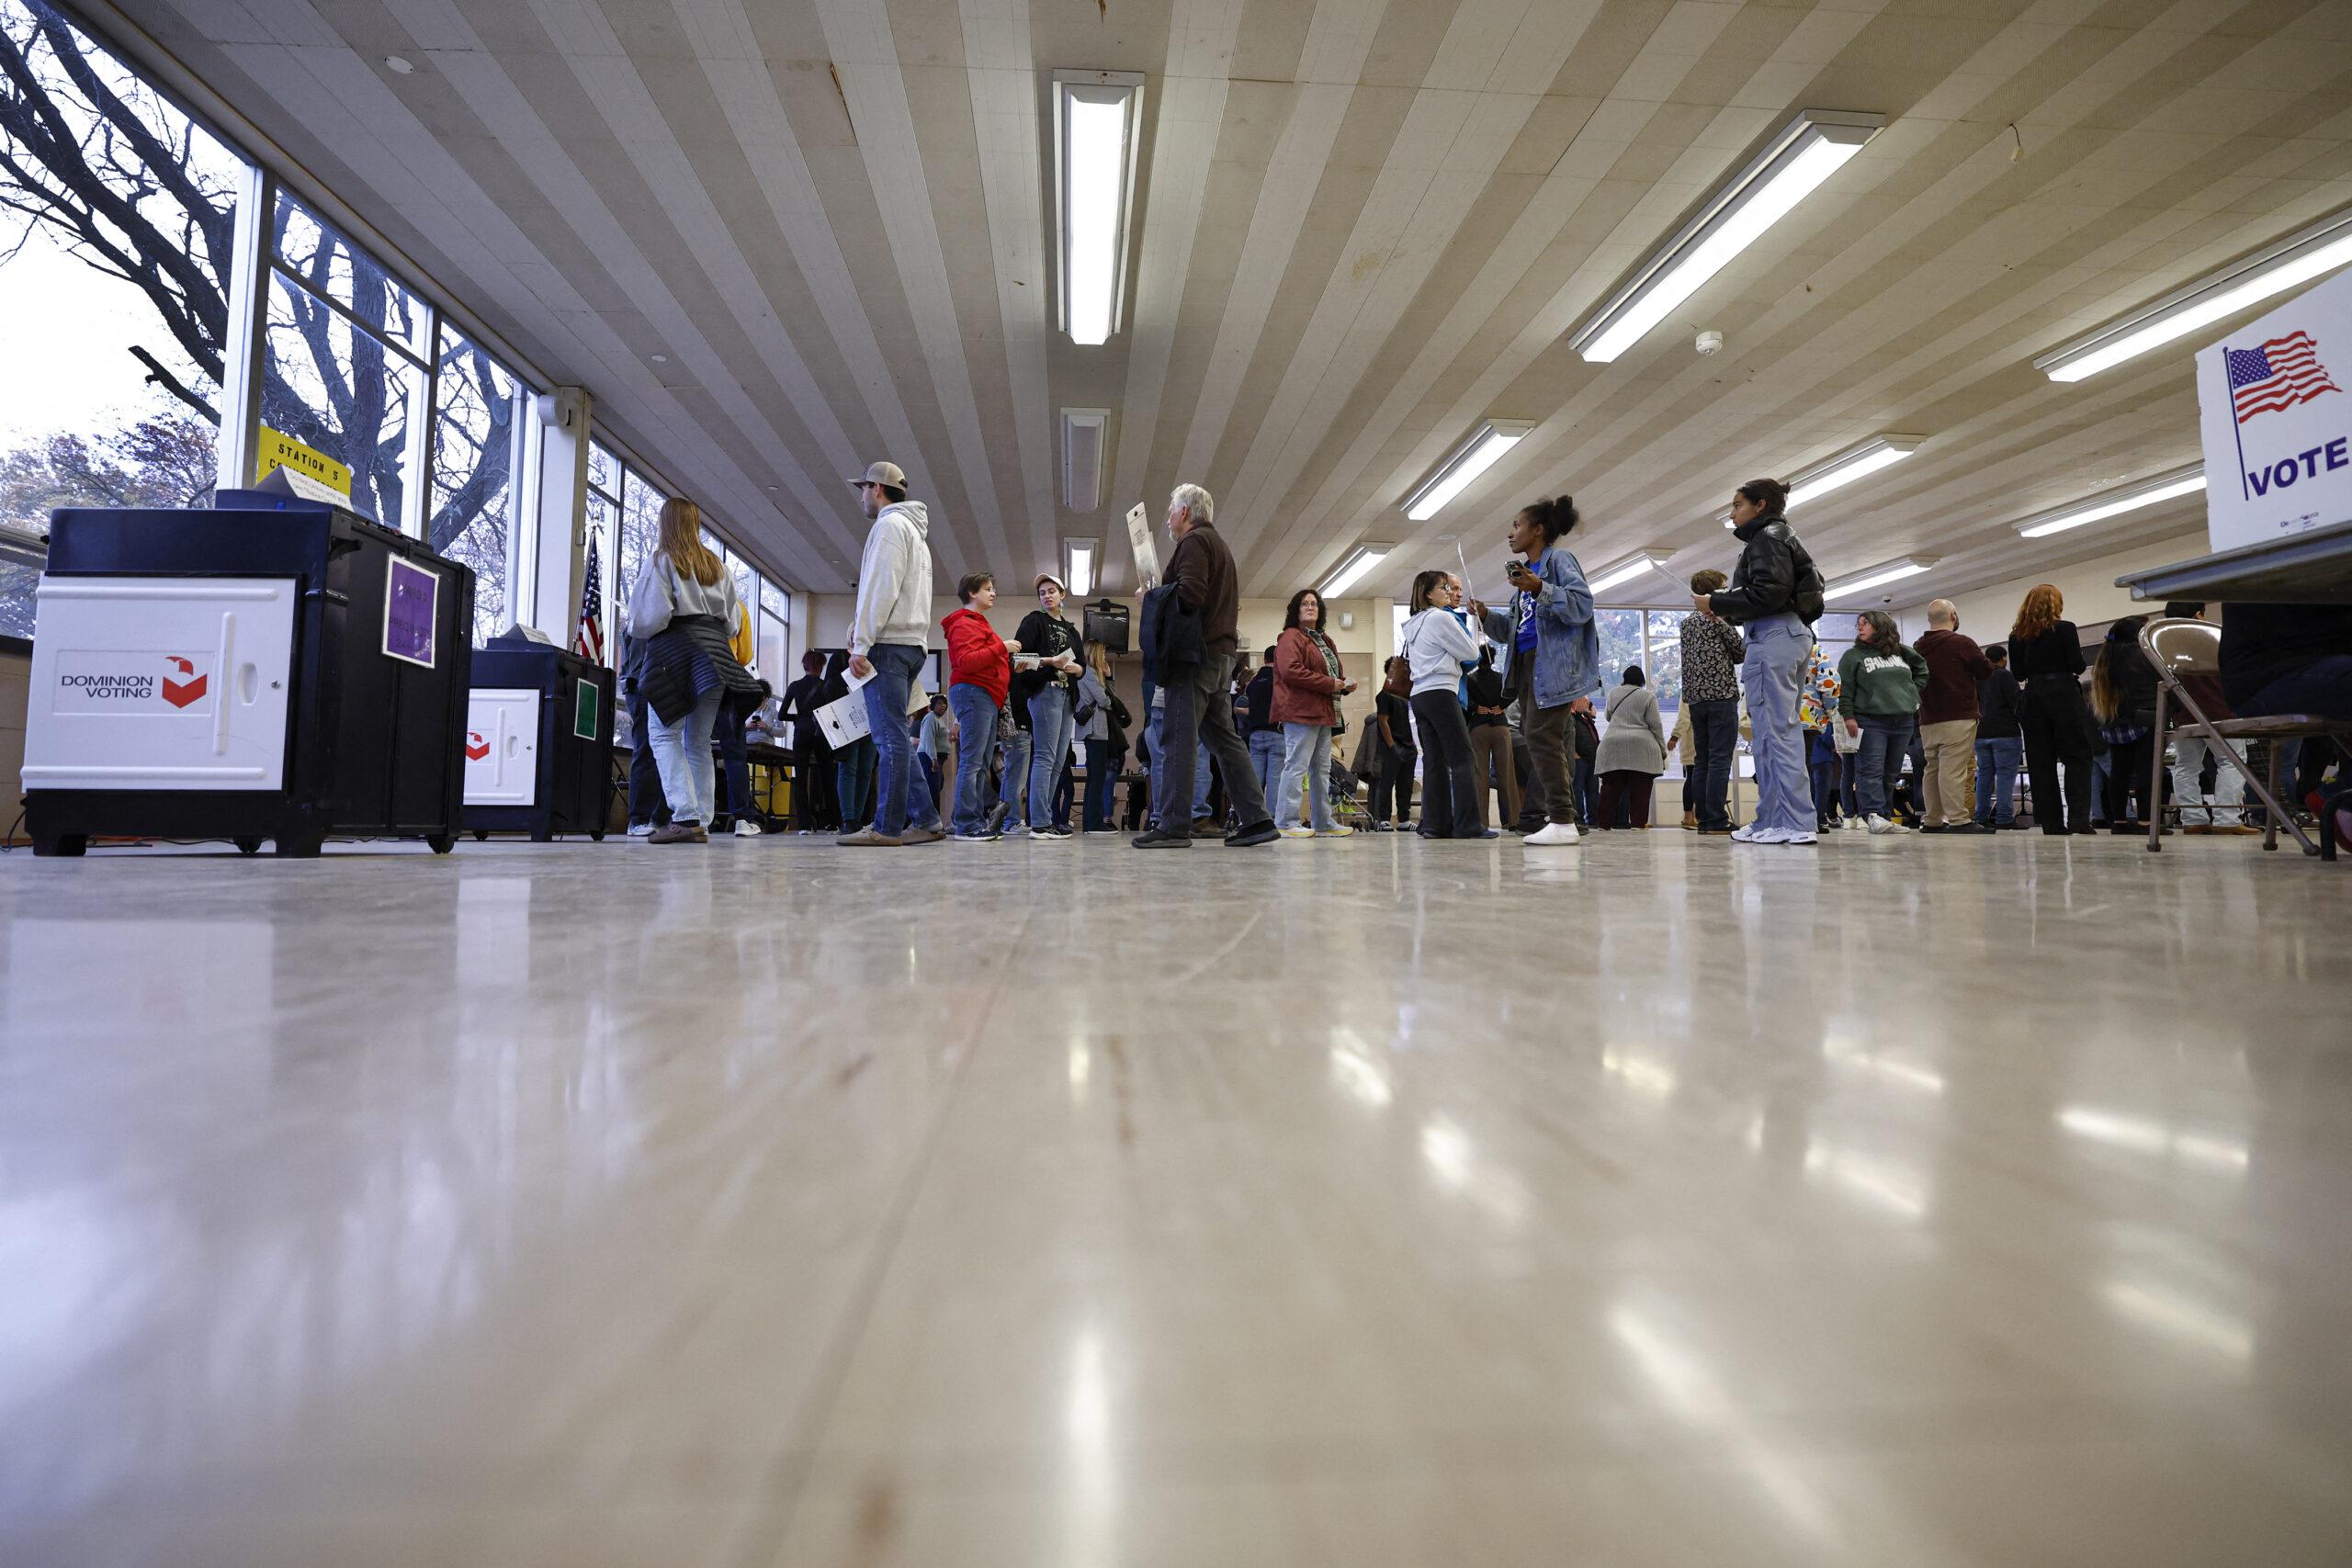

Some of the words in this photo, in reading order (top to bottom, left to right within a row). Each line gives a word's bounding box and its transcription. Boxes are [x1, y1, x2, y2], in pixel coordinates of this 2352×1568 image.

[278, 444, 325, 473] STATION
[2247, 436, 2349, 497] VOTE
[61, 675, 153, 687] DOMINION
[85, 688, 153, 699] VOTING
